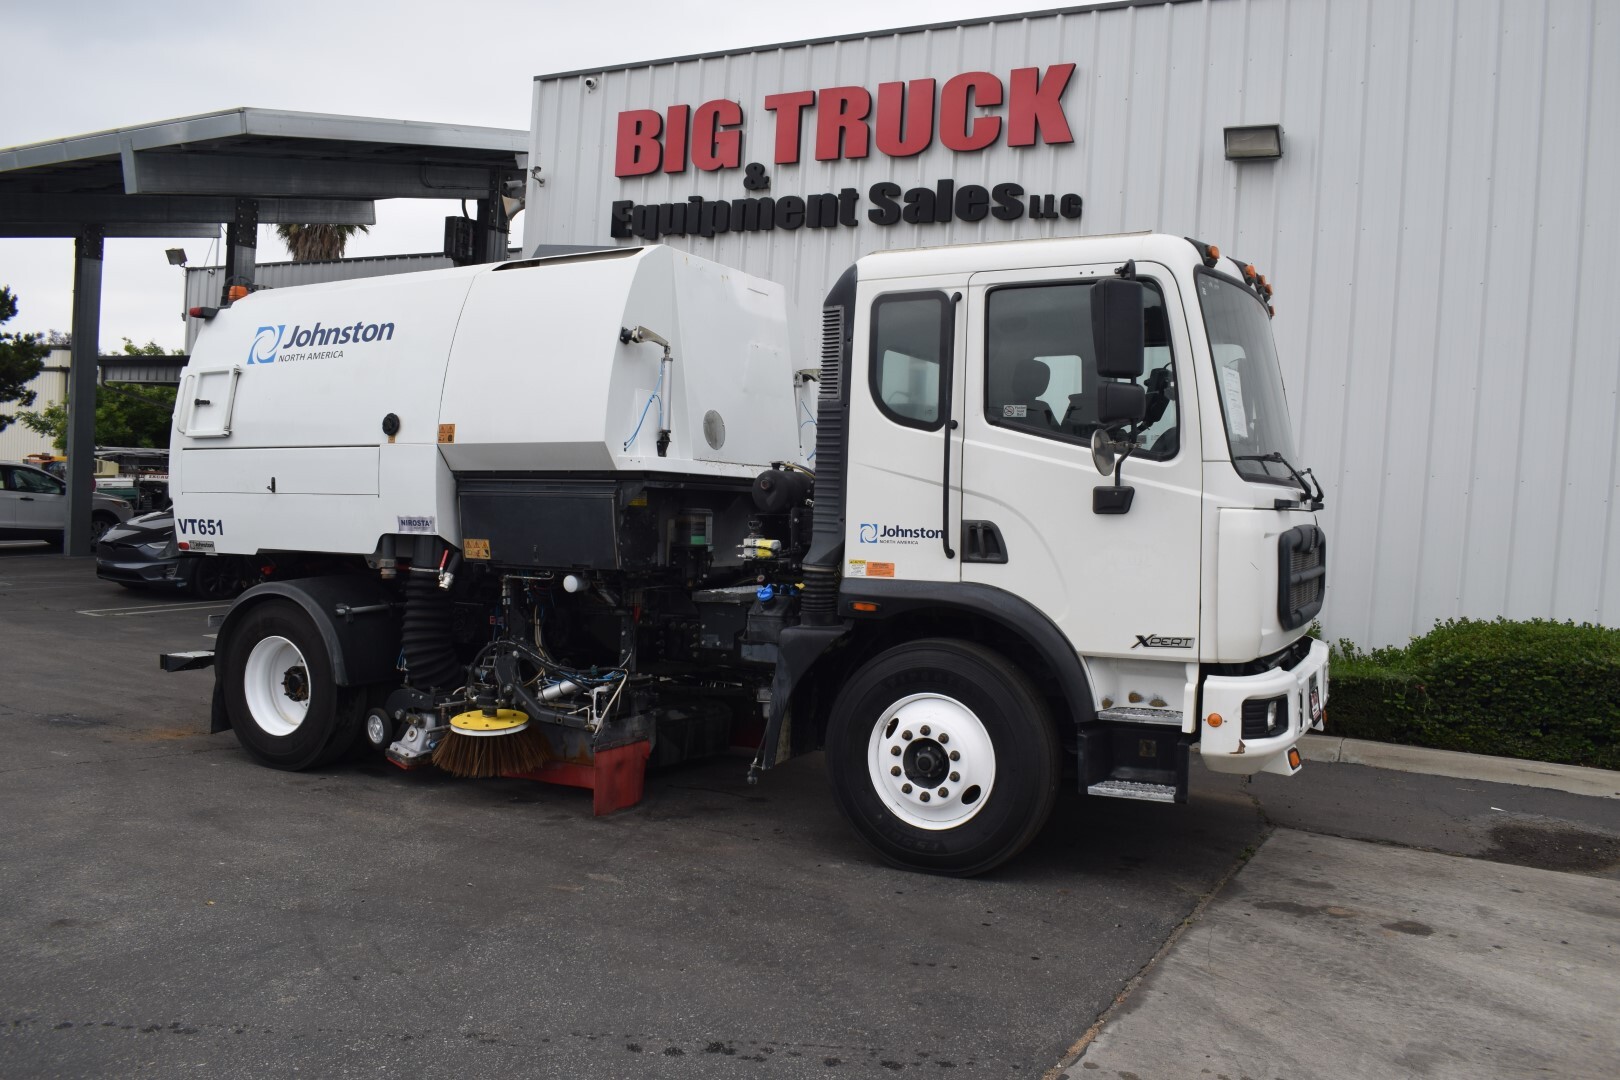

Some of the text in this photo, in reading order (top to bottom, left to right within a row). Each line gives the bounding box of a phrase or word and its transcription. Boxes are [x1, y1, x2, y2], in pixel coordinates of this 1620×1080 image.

[615, 63, 1077, 178] BIG TRUCK
[743, 162, 770, 191] &
[610, 178, 1082, 240] Equipment Sales LLC
[282, 321, 395, 349] Johnston
[278, 350, 344, 363] NORTH AMERICA
[177, 518, 224, 536] VT651
[880, 525, 944, 539] Johnston
[1130, 634, 1194, 648] XPERT
